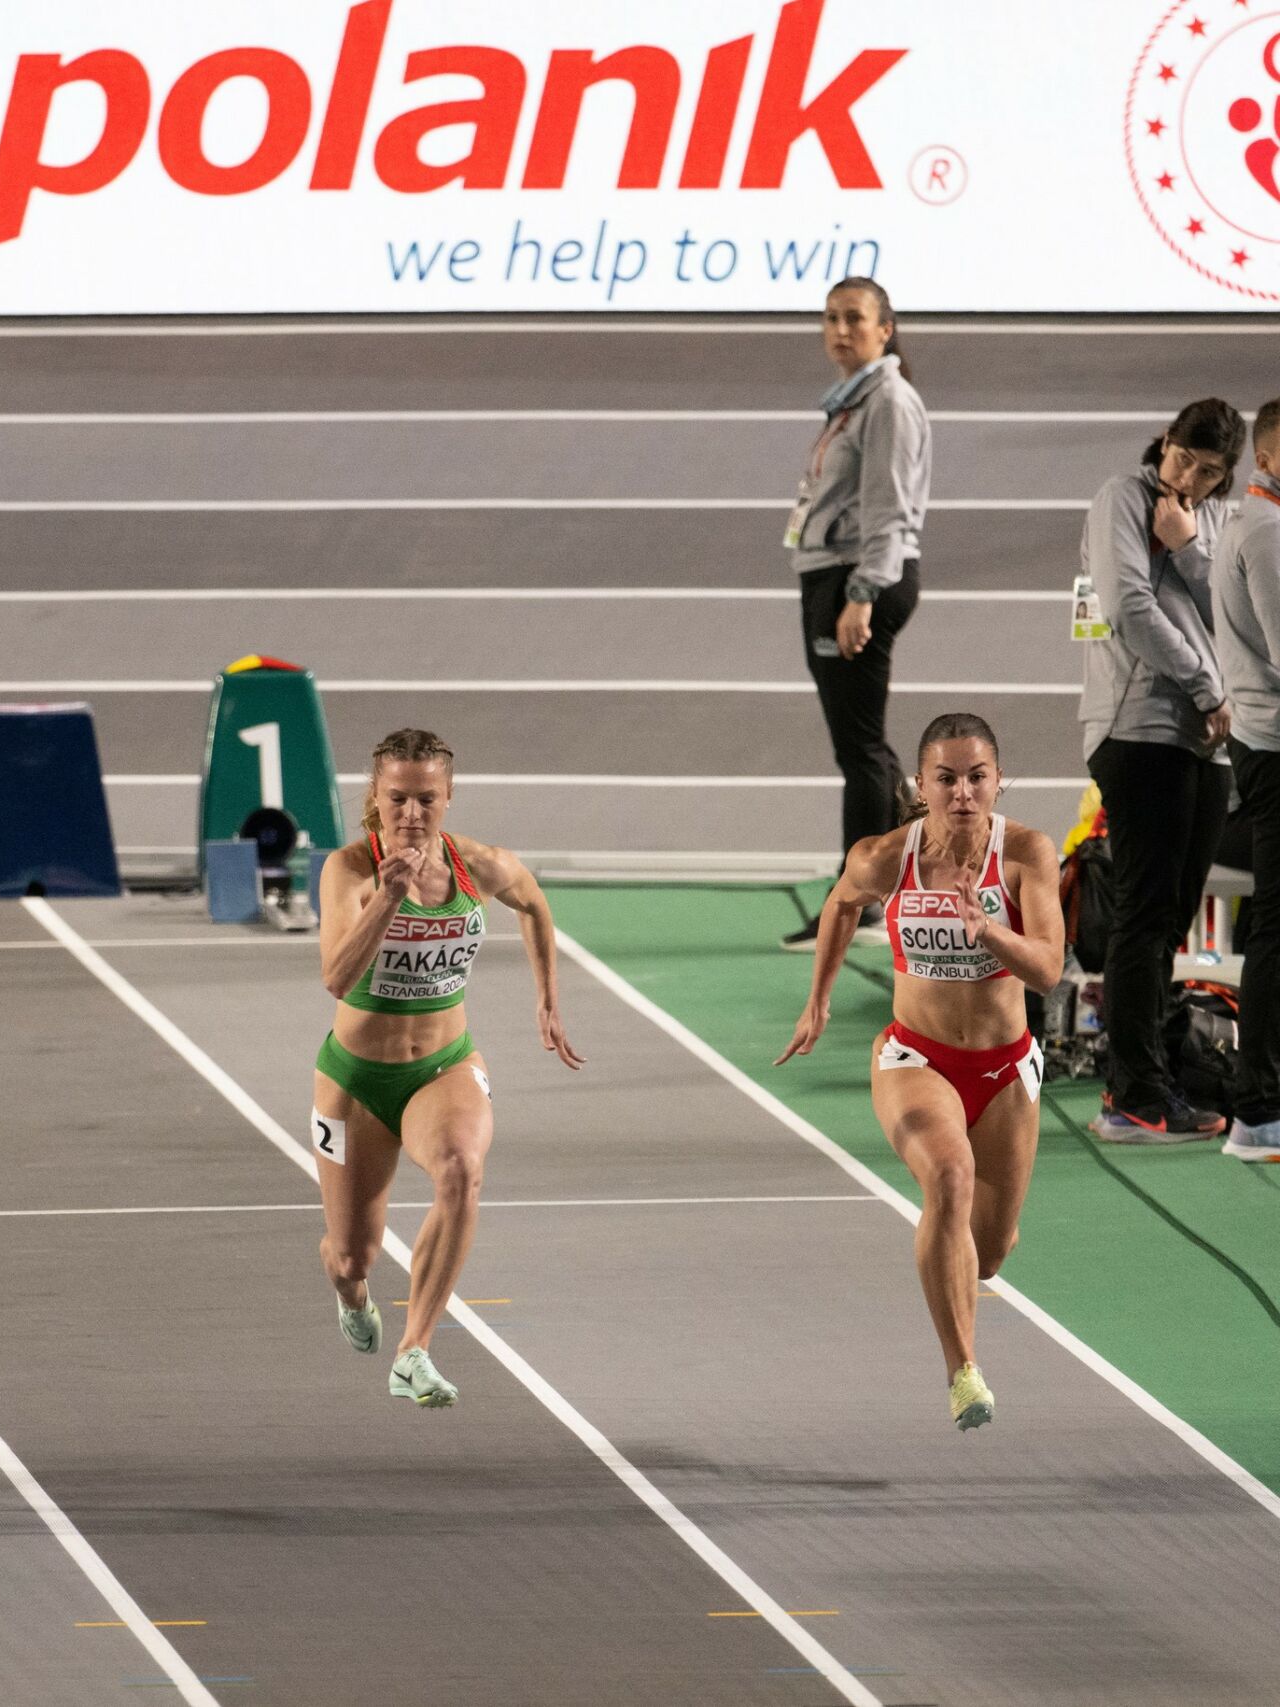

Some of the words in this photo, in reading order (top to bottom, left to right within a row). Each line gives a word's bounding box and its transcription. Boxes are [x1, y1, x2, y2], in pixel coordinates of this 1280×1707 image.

[387, 239, 481, 283] we
[505, 218, 647, 301] help
[673, 229, 738, 283] to
[764, 223, 880, 283] win
[237, 722, 283, 809] 1
[902, 896, 958, 915] SPA
[387, 919, 464, 939] SPAR
[902, 926, 984, 951] SCICLU
[382, 942, 479, 973] TAKÁCS
[914, 962, 975, 979] ISTANBUL
[976, 959, 1003, 977] 202
[954, 954, 987, 964] CLEAN
[378, 983, 440, 998] ISTANBUL
[1030, 1054, 1041, 1084] 1
[317, 1120, 334, 1155] 2
